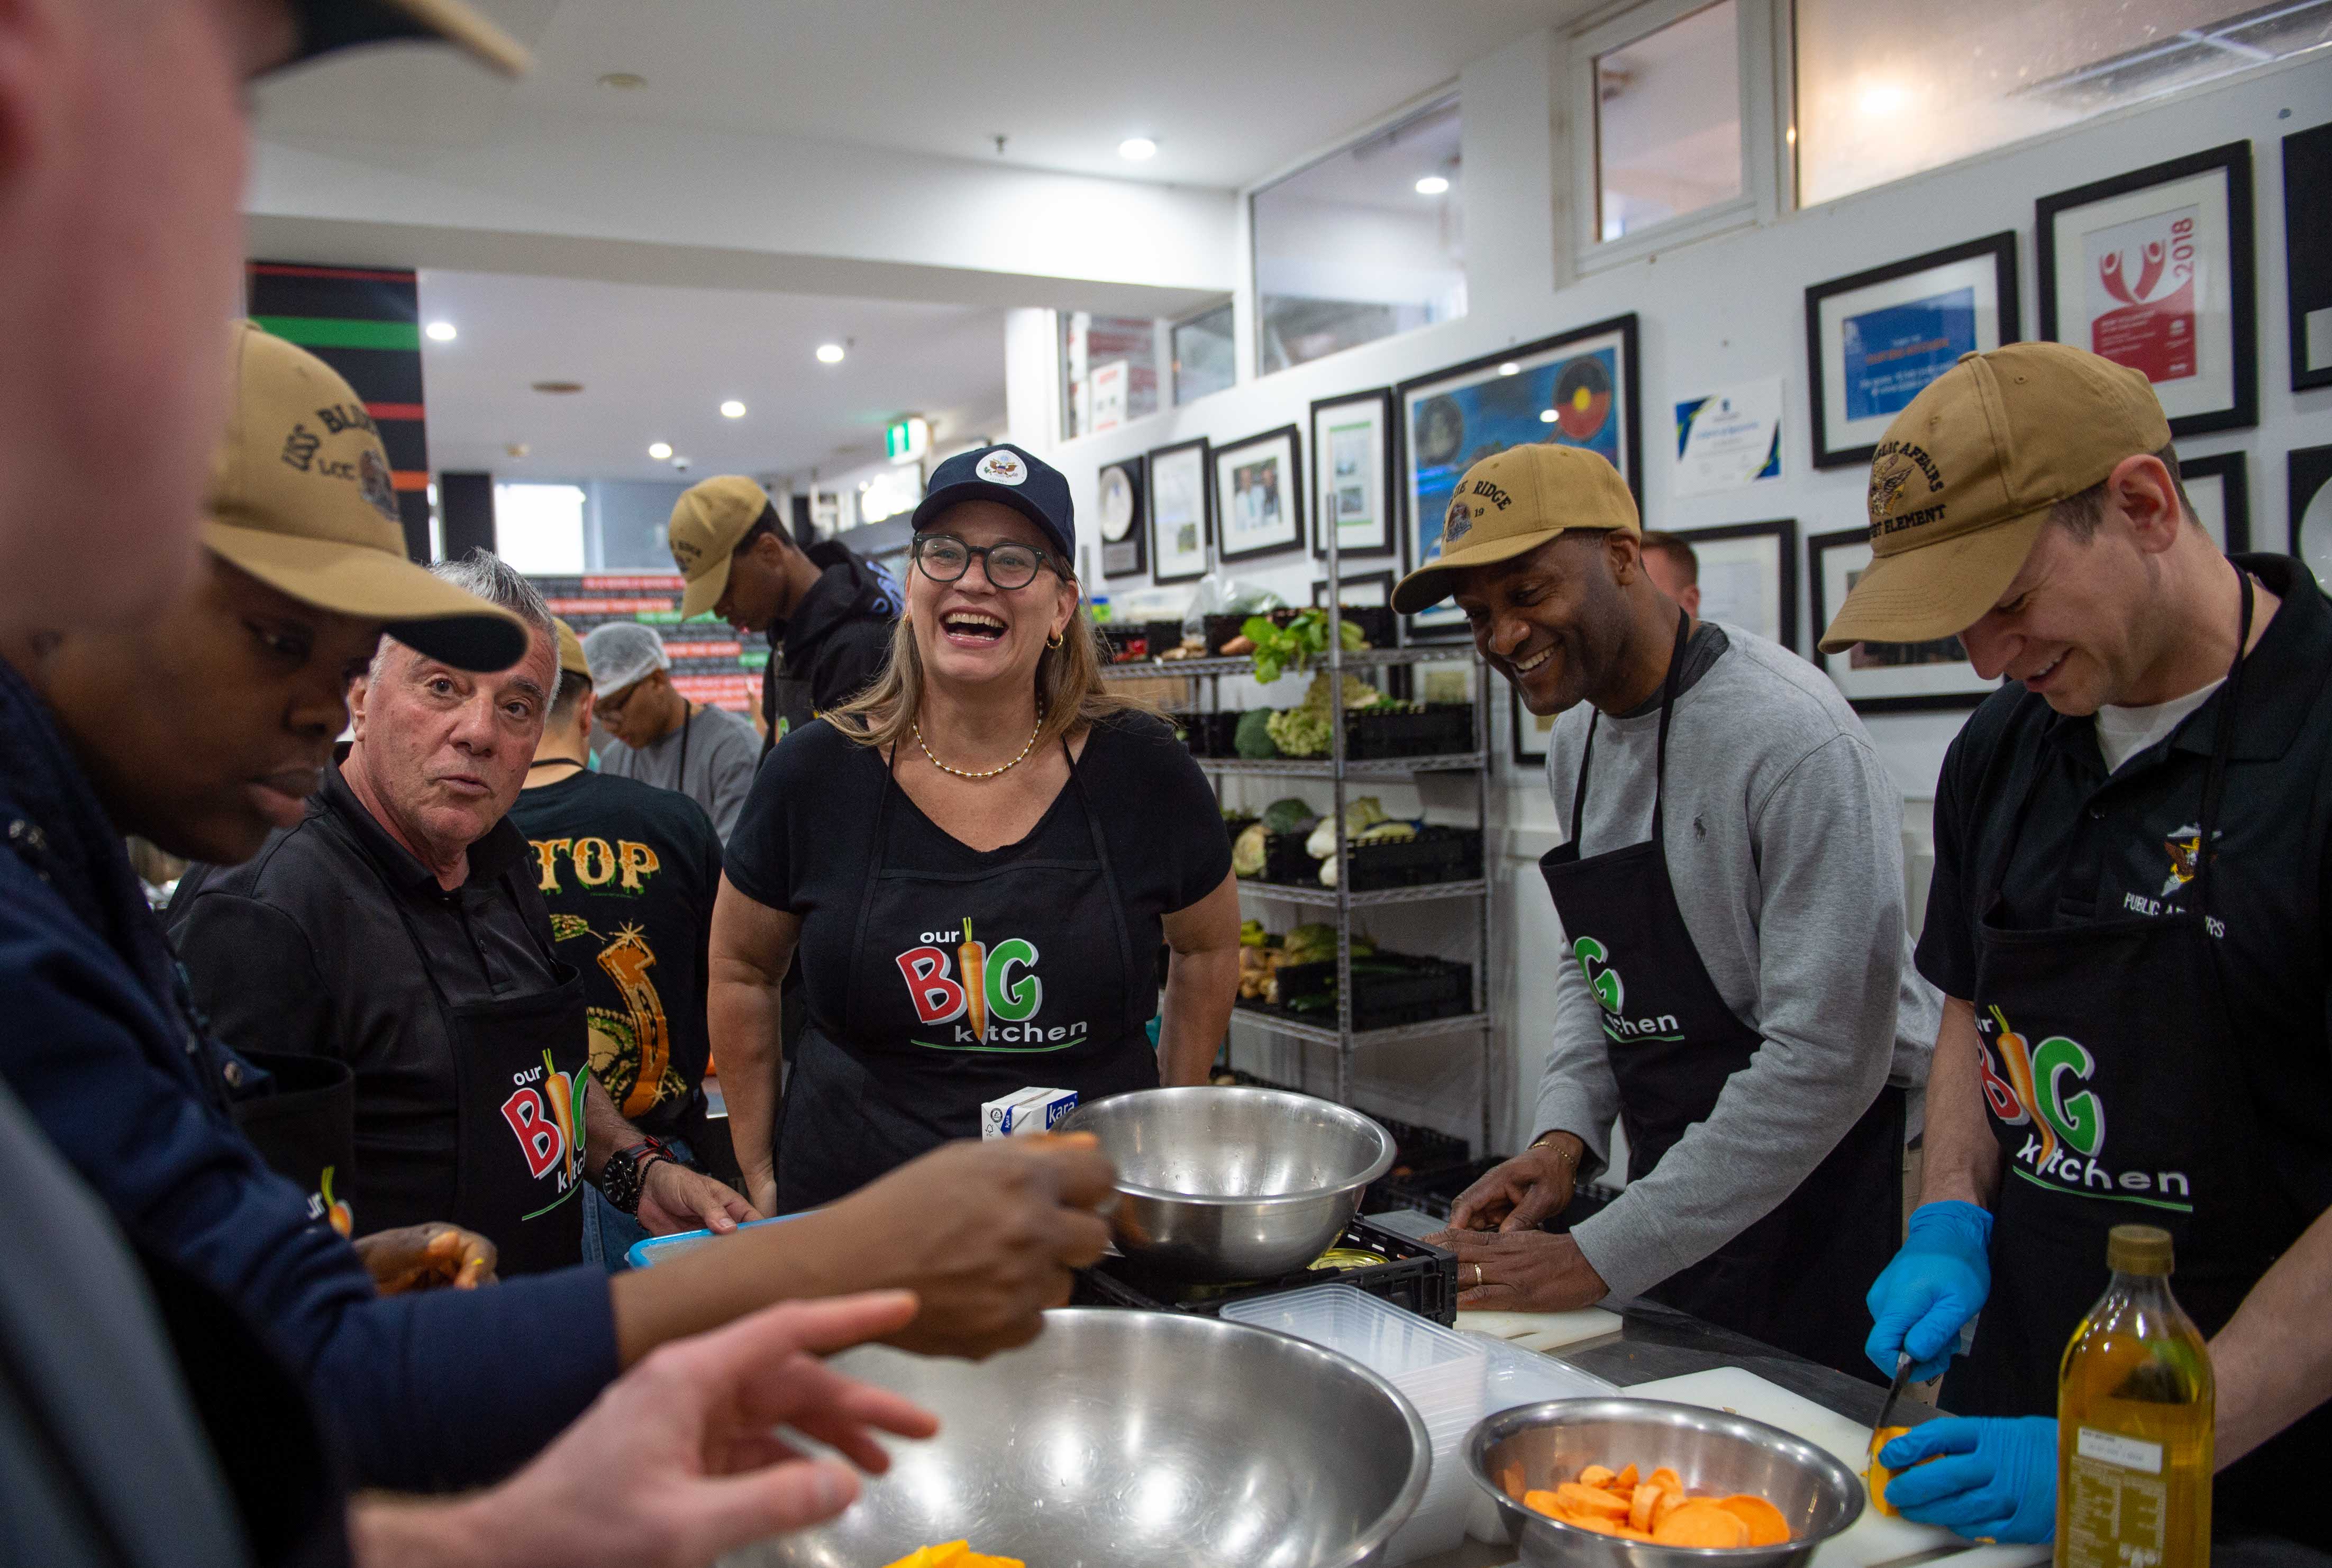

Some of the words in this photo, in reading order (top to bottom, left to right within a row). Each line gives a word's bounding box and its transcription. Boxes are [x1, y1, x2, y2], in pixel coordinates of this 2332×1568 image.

[2171, 217, 2194, 278] 2018
[1472, 480, 1513, 512] RIDGE
[1474, 507, 1485, 518] 19
[1884, 504, 1947, 534] ELEMENT
[2124, 892, 2161, 916] PUBLIC
[919, 931, 960, 943] our
[513, 1065, 542, 1086] our
